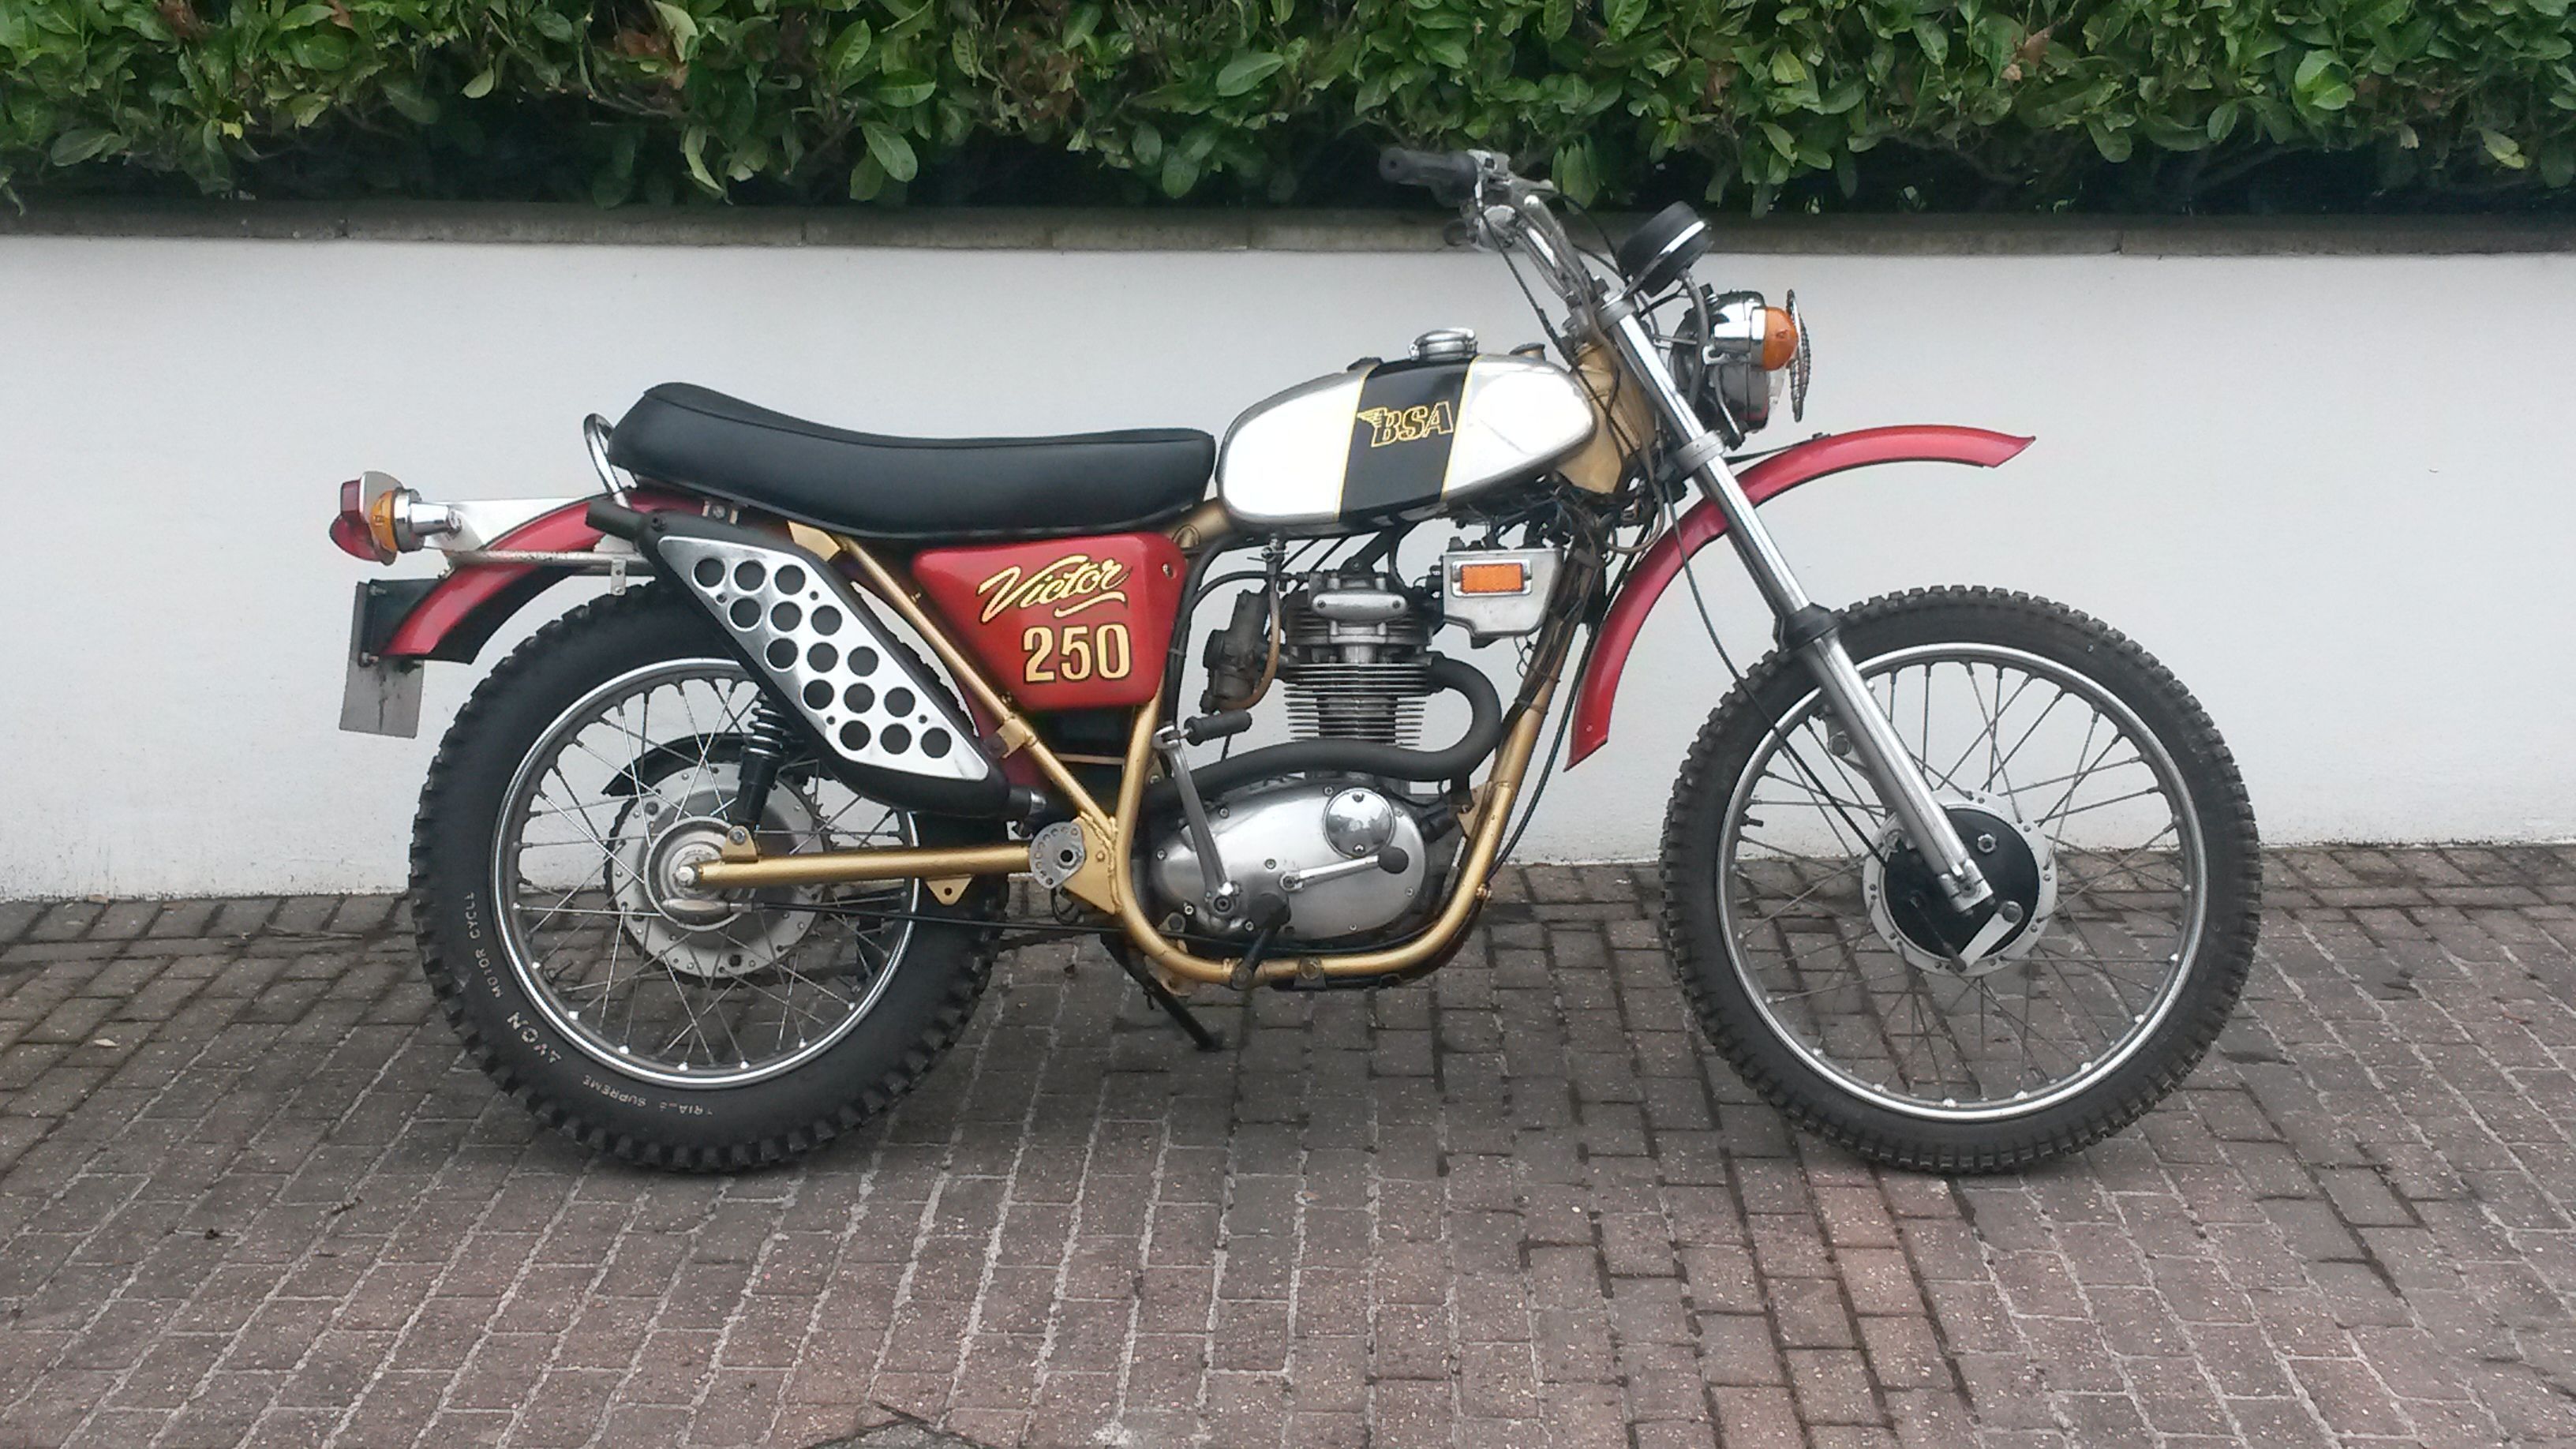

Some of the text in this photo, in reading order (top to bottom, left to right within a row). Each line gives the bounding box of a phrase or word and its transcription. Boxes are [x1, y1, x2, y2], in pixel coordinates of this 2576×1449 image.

[1357, 401, 1454, 447] BSA
[976, 554, 1133, 623] Victor
[1023, 623, 1131, 683] 250
[507, 1011, 562, 1063] AVON
[582, 1074, 647, 1107] SUPREME
